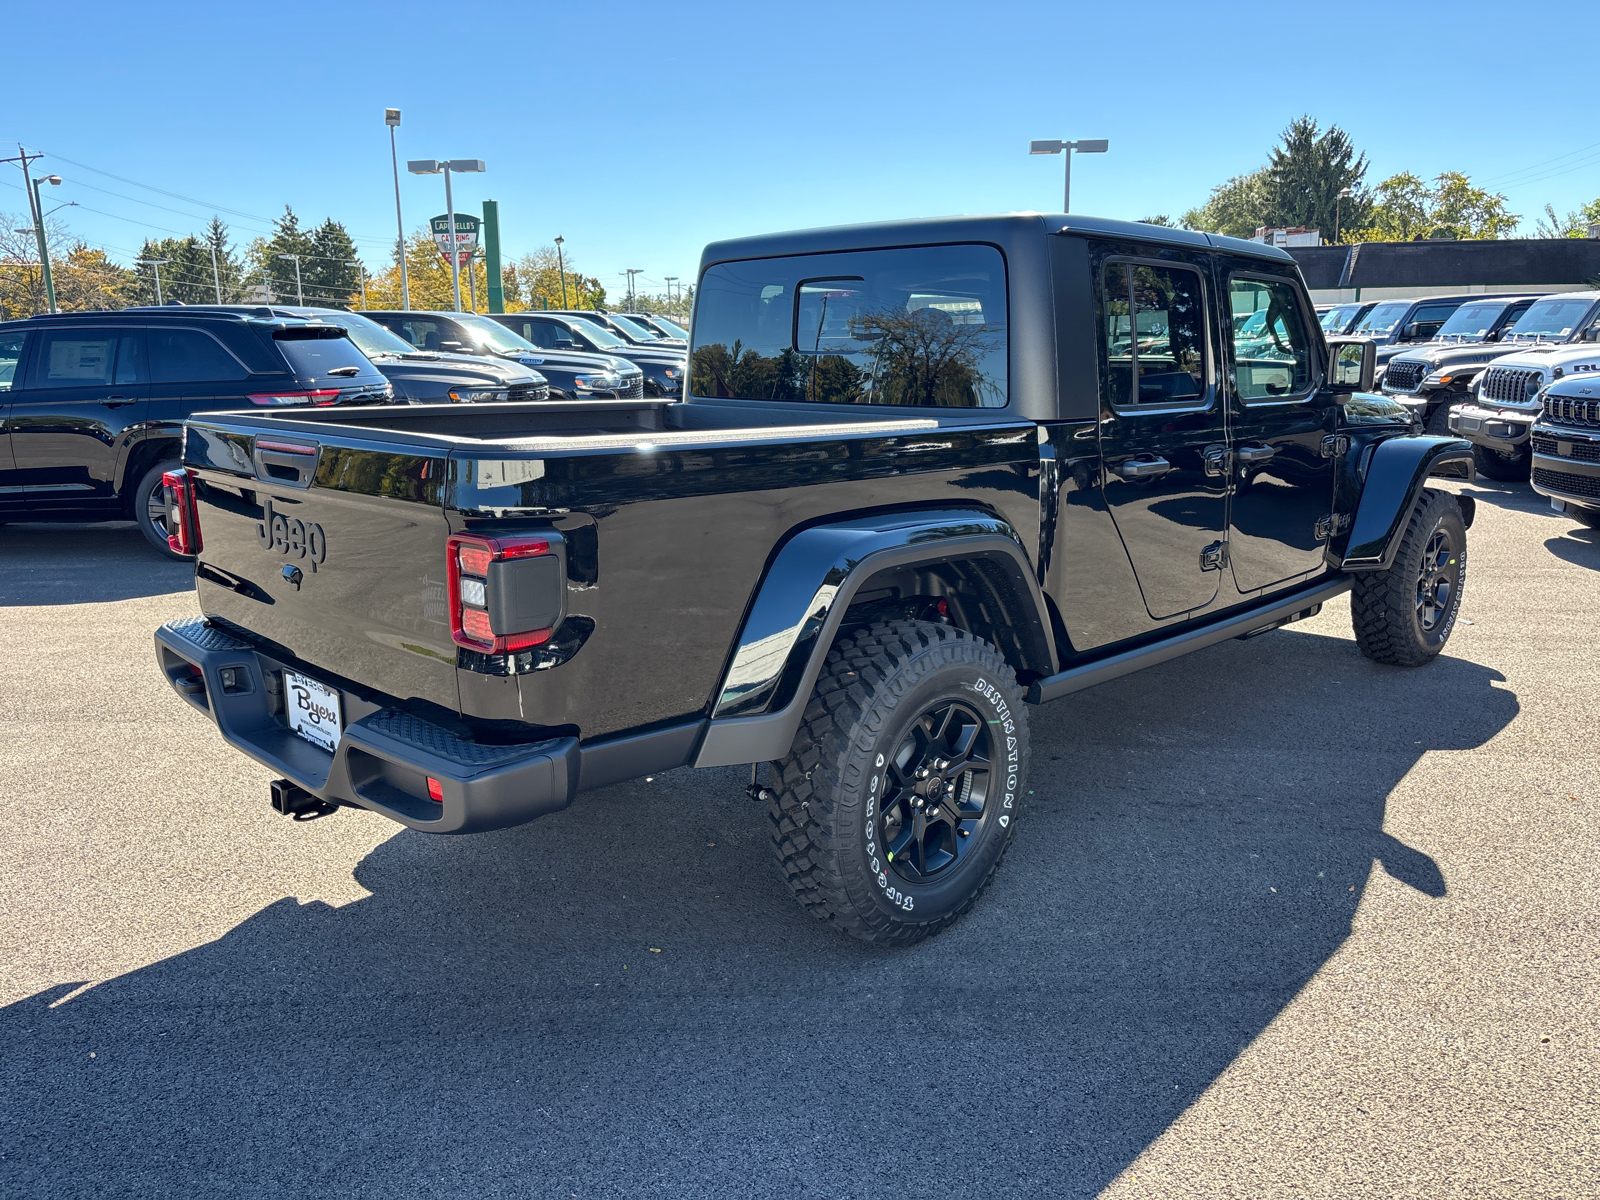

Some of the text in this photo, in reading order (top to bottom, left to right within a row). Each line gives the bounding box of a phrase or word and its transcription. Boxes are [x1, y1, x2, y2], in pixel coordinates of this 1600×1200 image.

[441, 234, 470, 242] CATRING
[256, 500, 327, 573] Jeep
[1337, 513, 1351, 529] eep
[1442, 551, 1467, 638] DESTINATION
[974, 677, 1018, 809] DESTINATION
